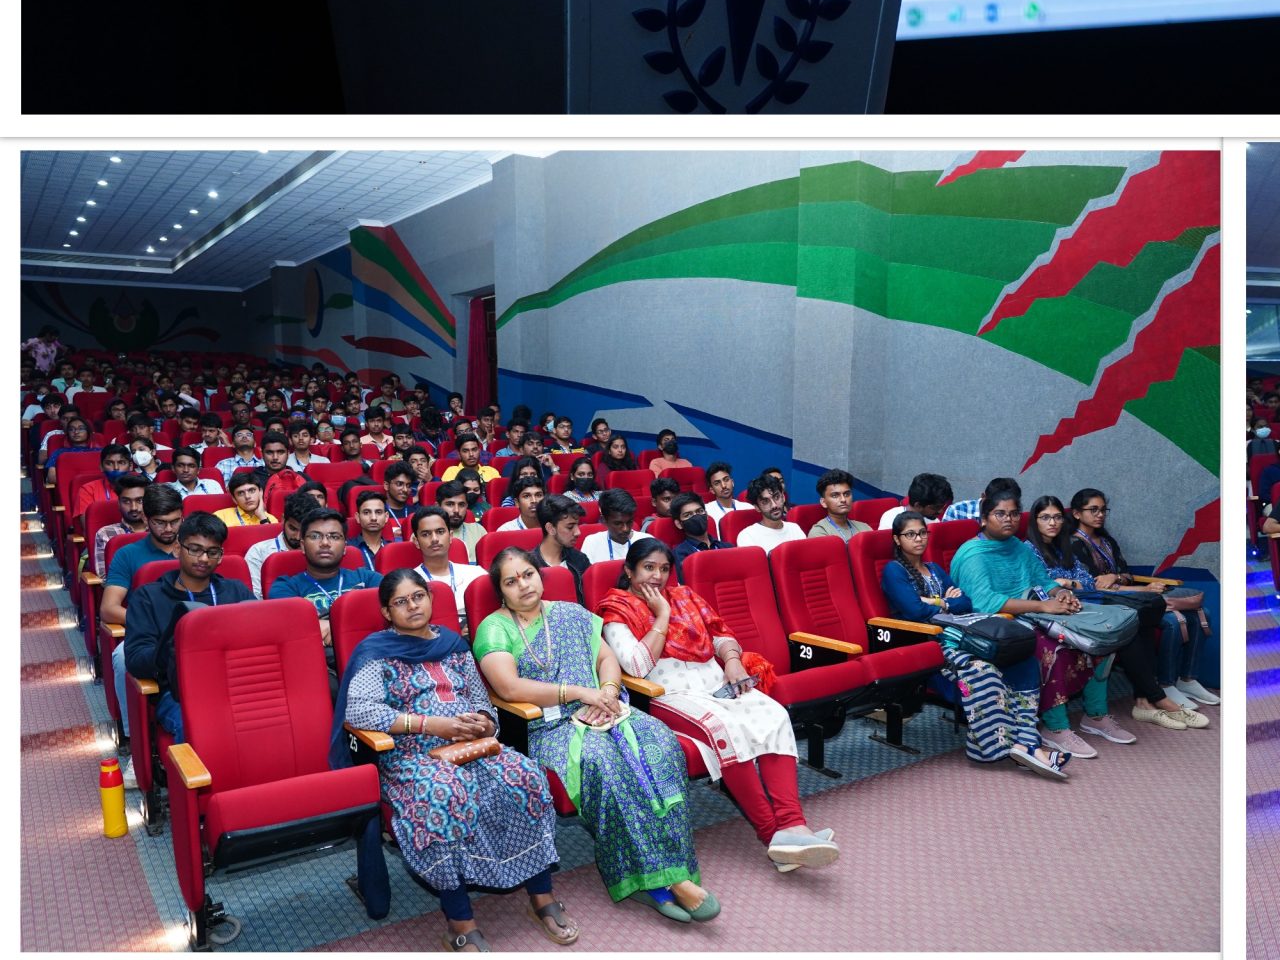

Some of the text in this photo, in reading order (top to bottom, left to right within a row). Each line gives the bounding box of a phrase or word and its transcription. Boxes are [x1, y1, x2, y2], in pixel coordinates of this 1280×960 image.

[877, 628, 891, 643] 30
[800, 644, 813, 660] 29
[349, 733, 358, 753] 25
